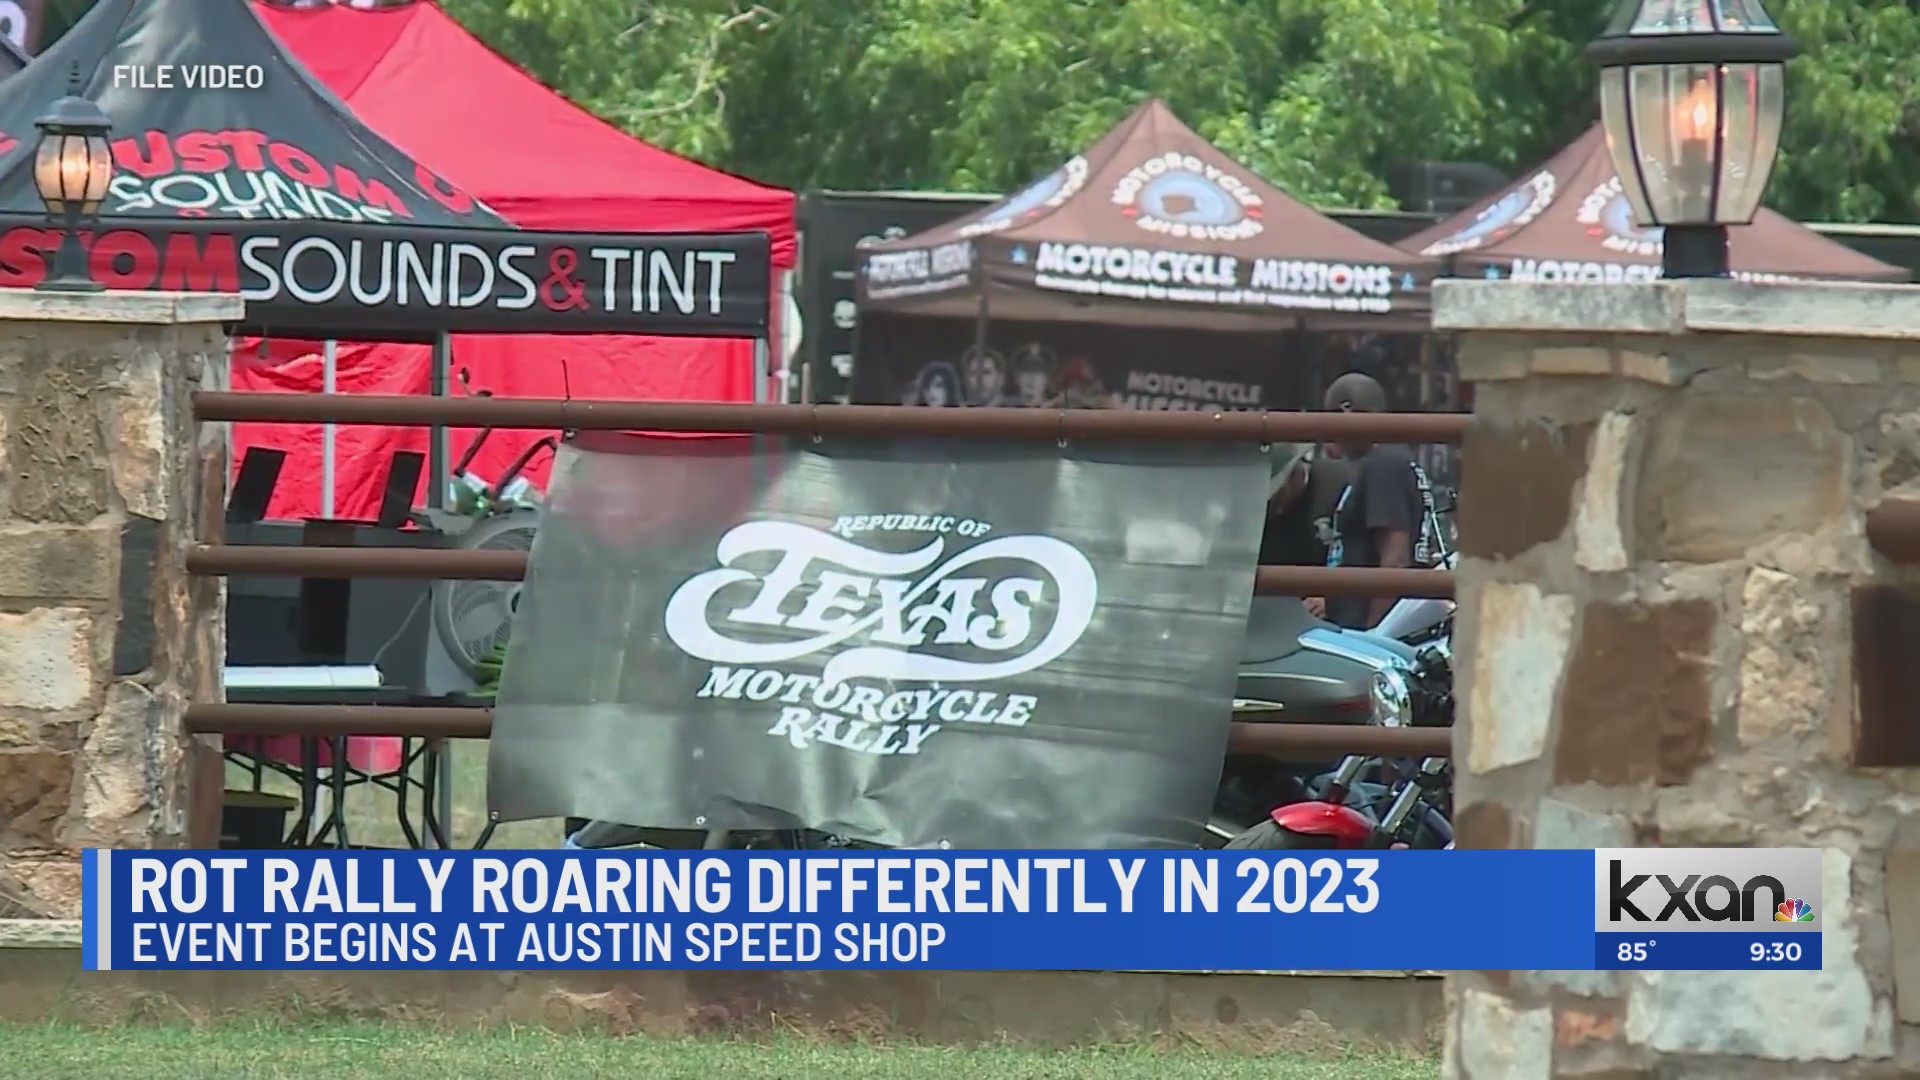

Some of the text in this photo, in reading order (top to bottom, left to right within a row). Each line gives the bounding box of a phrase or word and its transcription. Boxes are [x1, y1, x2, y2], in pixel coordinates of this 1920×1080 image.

[112, 131, 414, 218] USTOM
[1035, 242, 1238, 285] MOTORCYCLE
[1251, 258, 1392, 295] MISSIONS
[1127, 370, 1262, 403] MOTORCYCLE
[831, 514, 992, 538] REPUBLIC OF
[665, 520, 1098, 682] TEXAS
[697, 666, 1038, 726] MOTORCYCLE
[768, 707, 941, 755] RALLY
